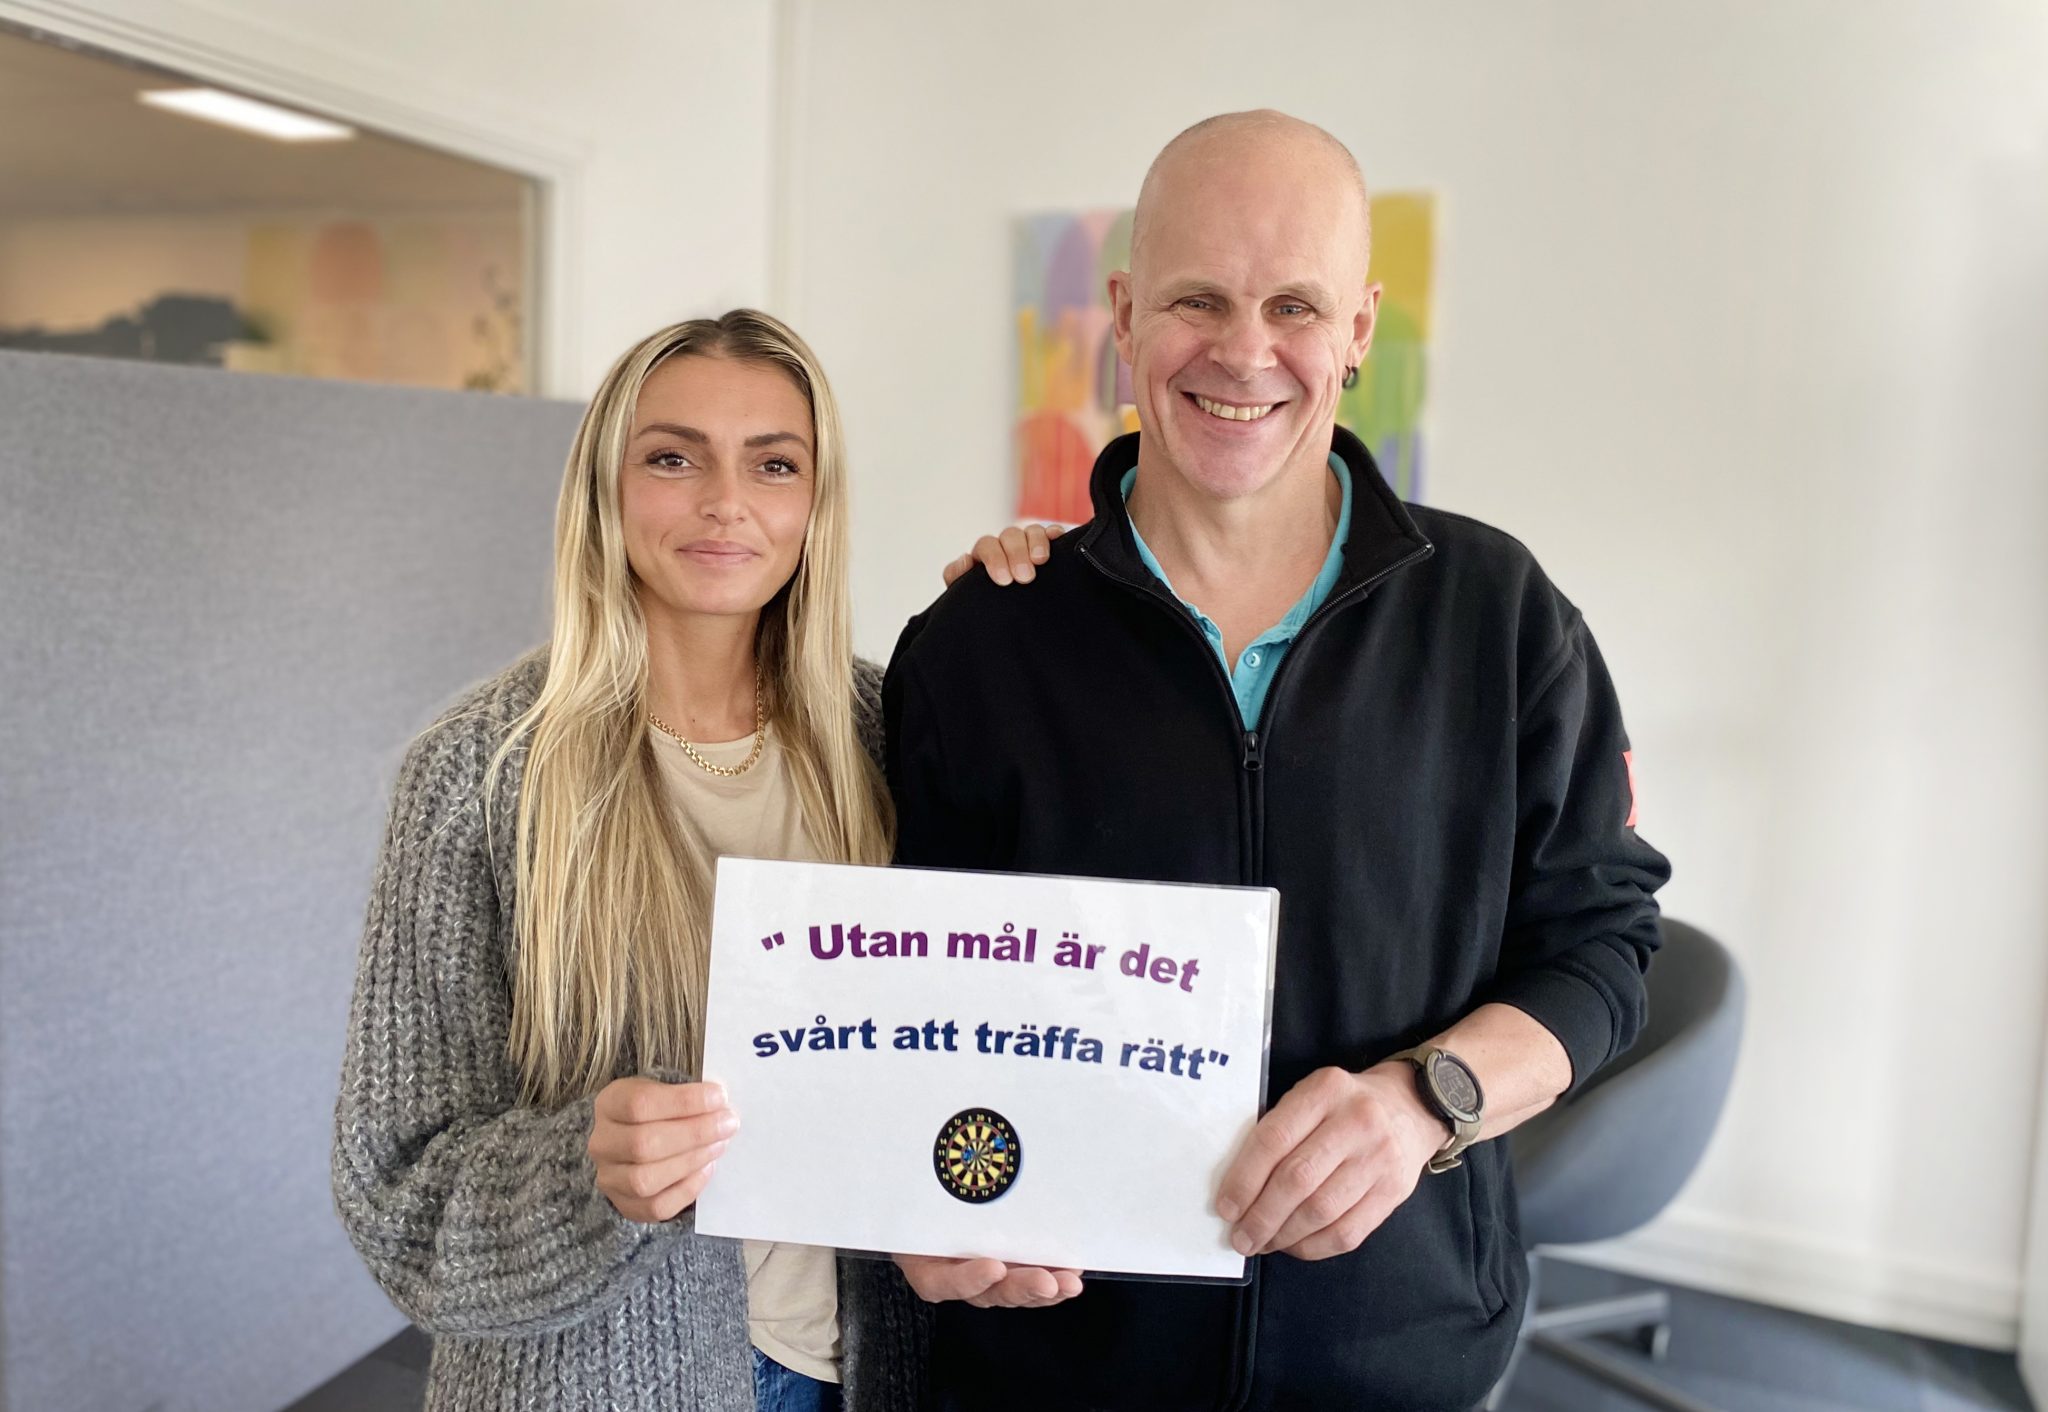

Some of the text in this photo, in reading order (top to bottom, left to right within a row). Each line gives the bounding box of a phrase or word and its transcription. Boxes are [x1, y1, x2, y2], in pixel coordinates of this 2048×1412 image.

[809, 924, 928, 960] Utan
[947, 923, 1037, 962] mål
[1054, 931, 1105, 971] är
[1121, 944, 1199, 992] det
[753, 1015, 1228, 1079] svårt att träffa rätt"
